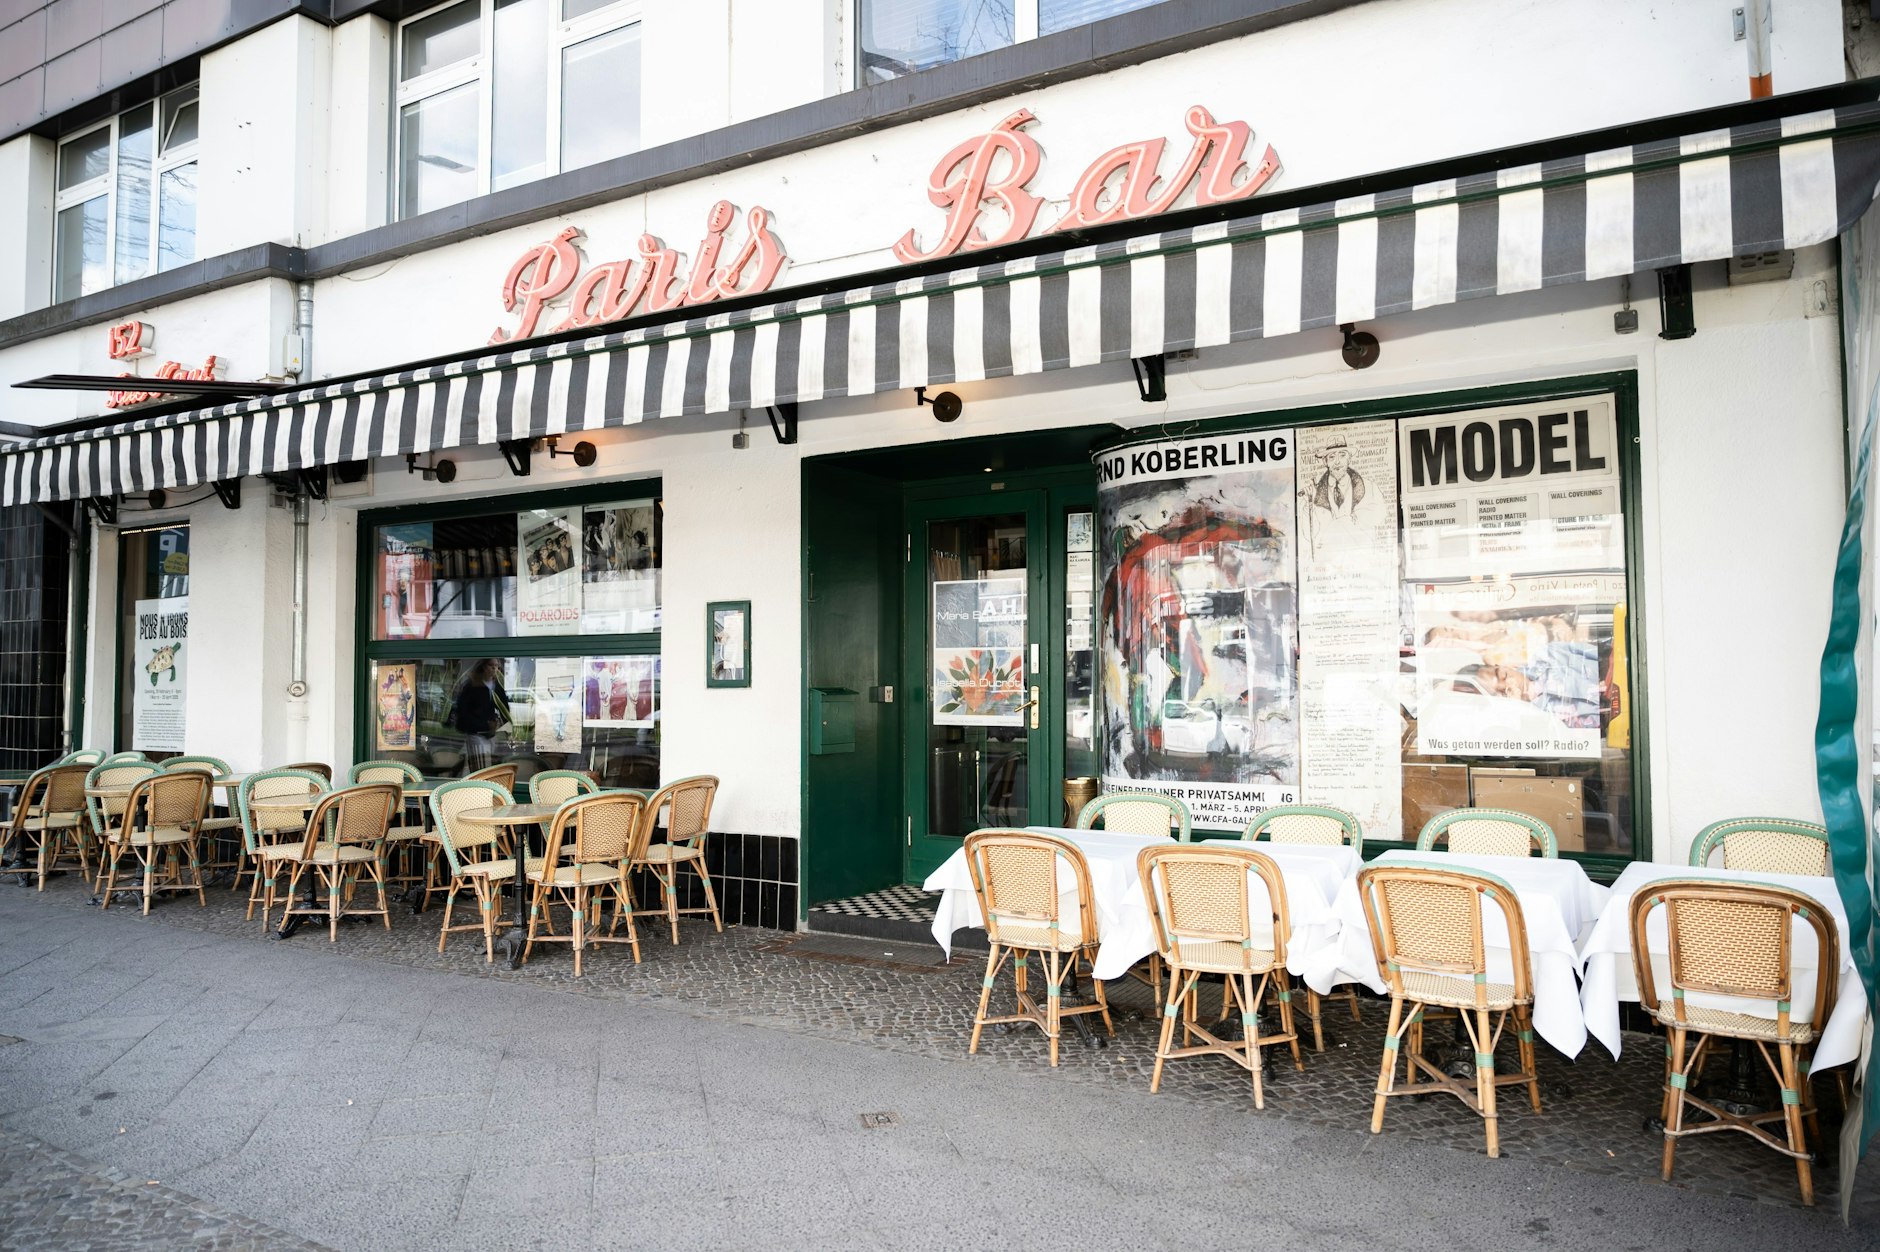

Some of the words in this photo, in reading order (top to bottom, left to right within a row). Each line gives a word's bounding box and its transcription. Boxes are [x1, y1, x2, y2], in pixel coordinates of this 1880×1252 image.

[487, 199, 787, 346] Paris
[892, 104, 1284, 265] Bar
[107, 320, 143, 360] 152
[1410, 409, 1606, 488] MODEL
[1131, 437, 1287, 476] KOBERLING
[1495, 496, 1527, 504] COVERINGS
[1568, 489, 1603, 498] COVERINGS
[1425, 502, 1456, 510] COVERINGS
[140, 613, 158, 627] NOUS
[519, 608, 579, 623] POLAROIDS
[937, 610, 969, 620] Maria
[140, 626, 157, 640] PLUS
[159, 625, 168, 639] AU
[980, 678, 1021, 688] Ducrot
[1428, 739, 1449, 749] Was
[1452, 739, 1480, 751] getan
[1484, 739, 1522, 750] werden
[1525, 740, 1549, 750] soll?
[1553, 740, 1589, 751] Radio?
[1200, 802, 1225, 812] MÄRZ
